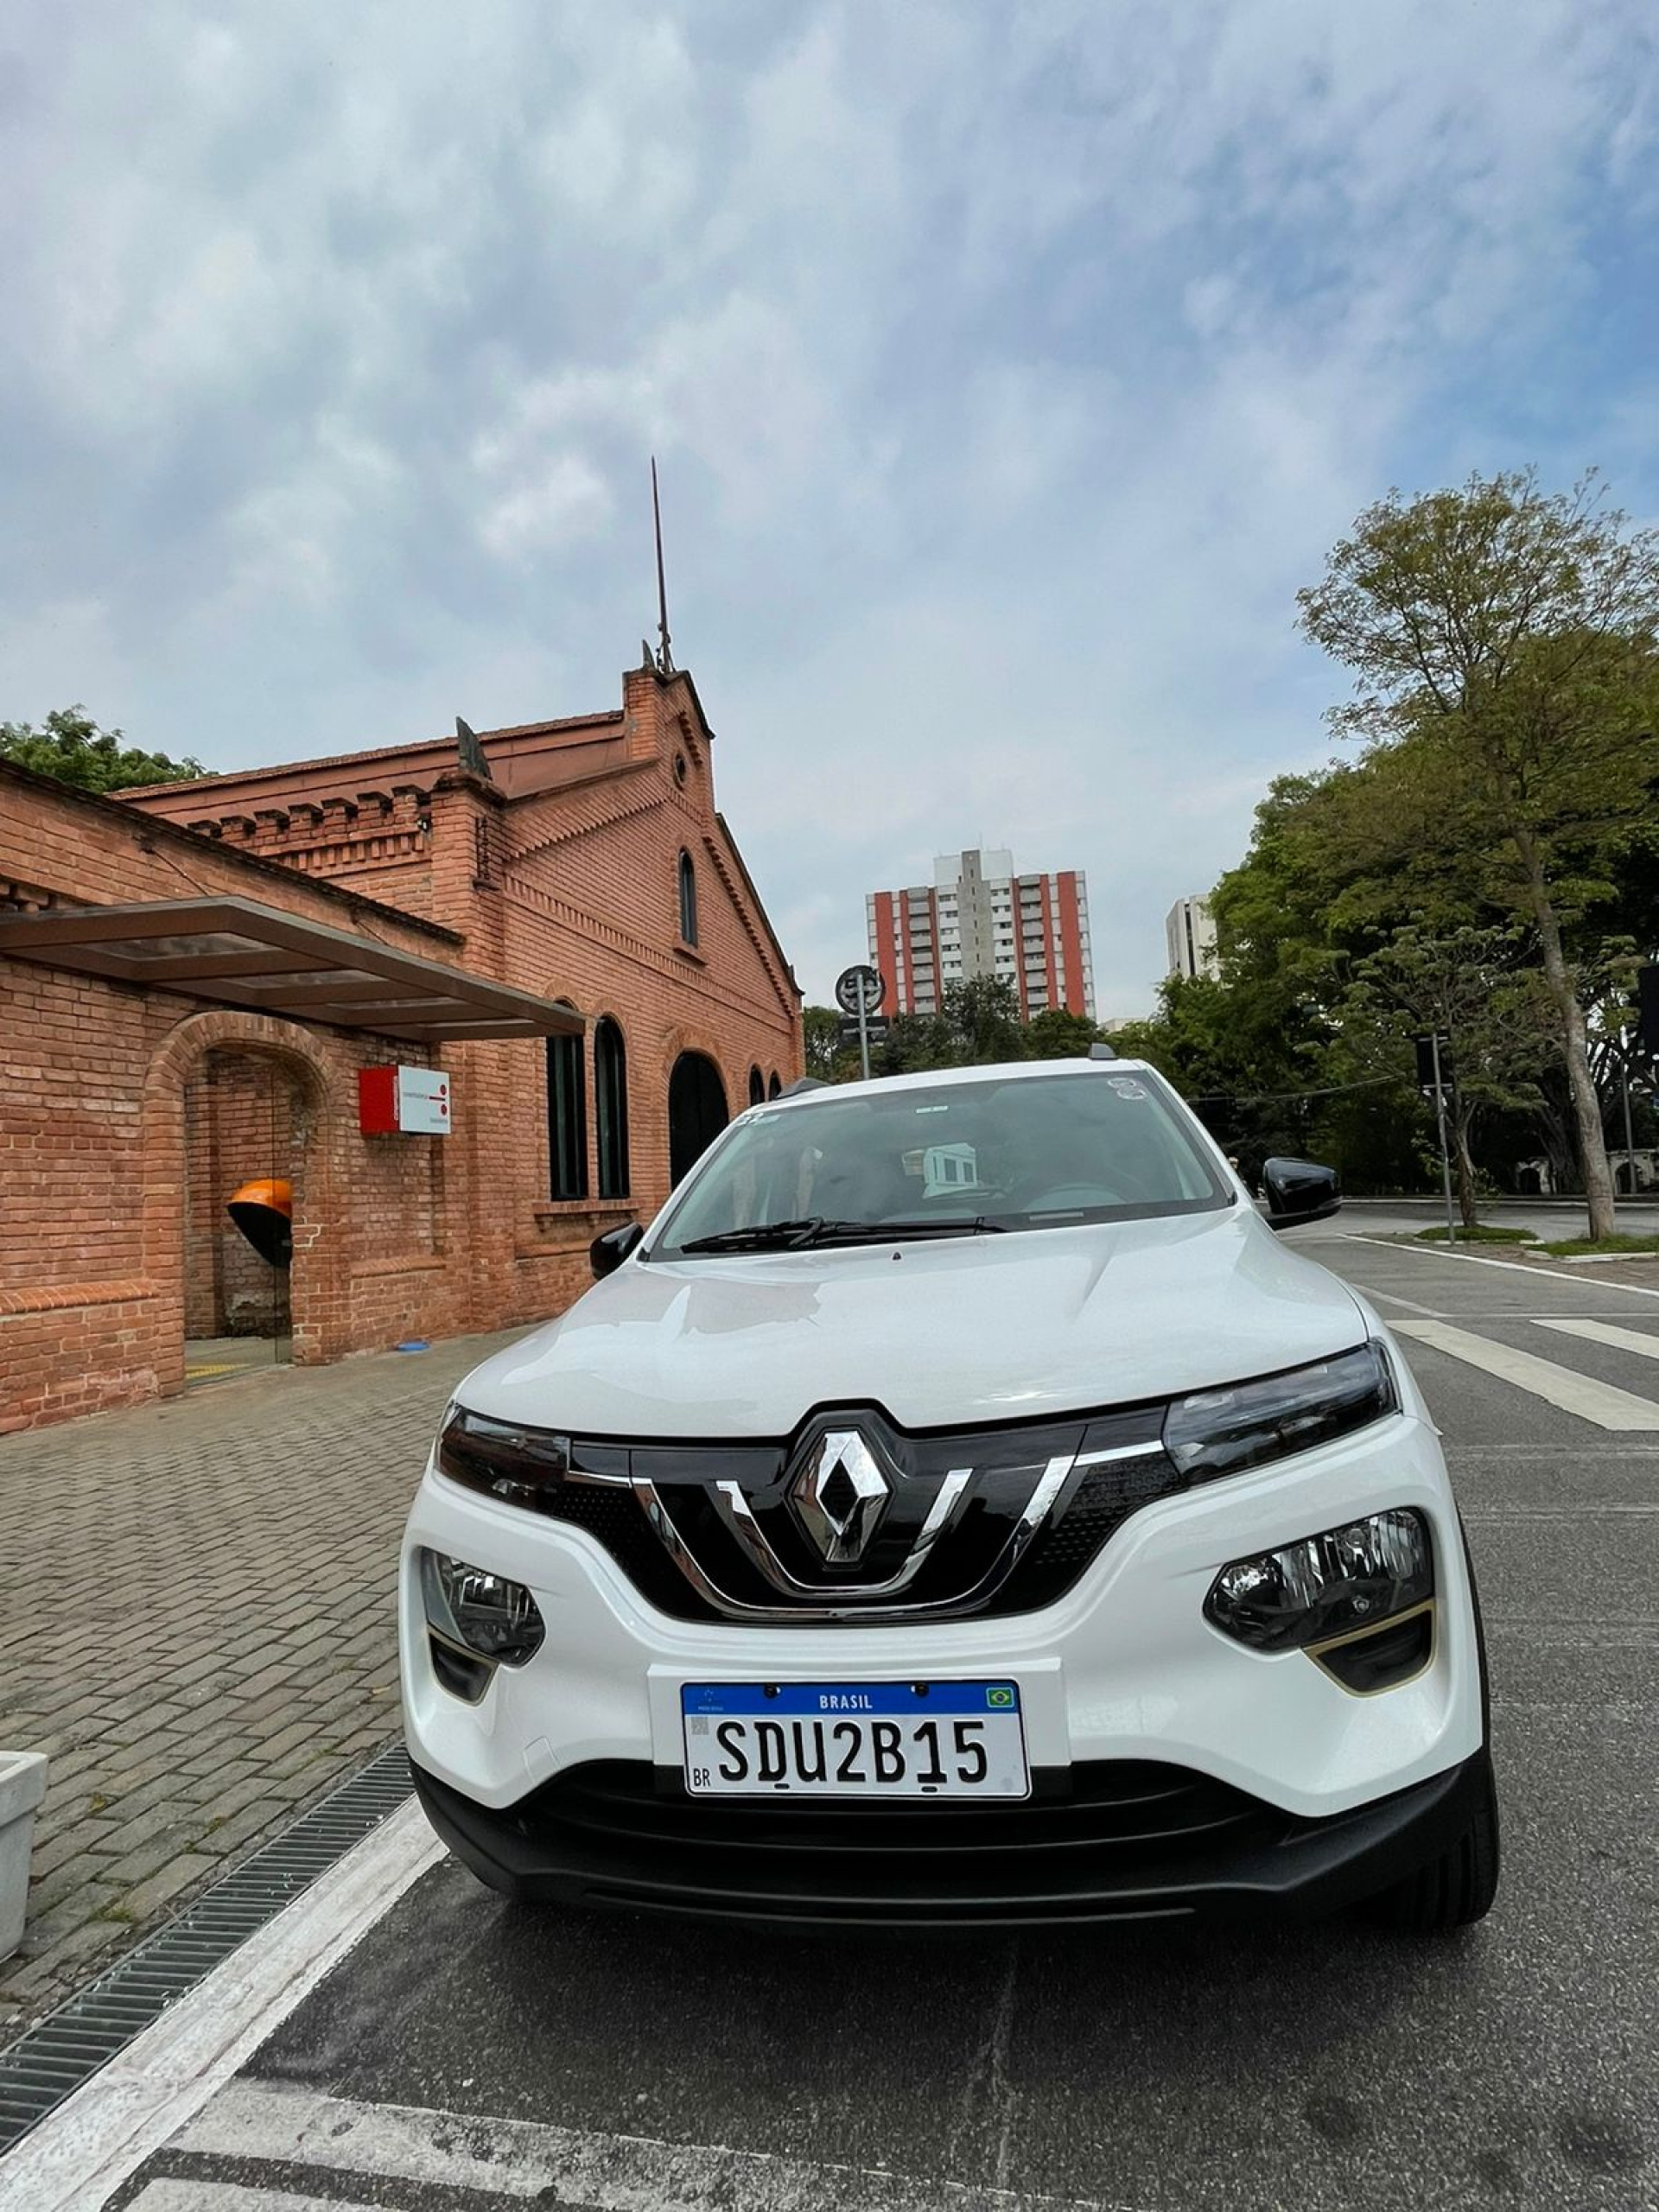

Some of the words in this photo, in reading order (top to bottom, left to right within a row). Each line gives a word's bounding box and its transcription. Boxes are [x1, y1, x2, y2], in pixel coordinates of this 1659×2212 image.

[819, 1695, 873, 1709] BRASIL
[716, 1720, 988, 1783] SDU2B15
[693, 1768, 711, 1787] BR
